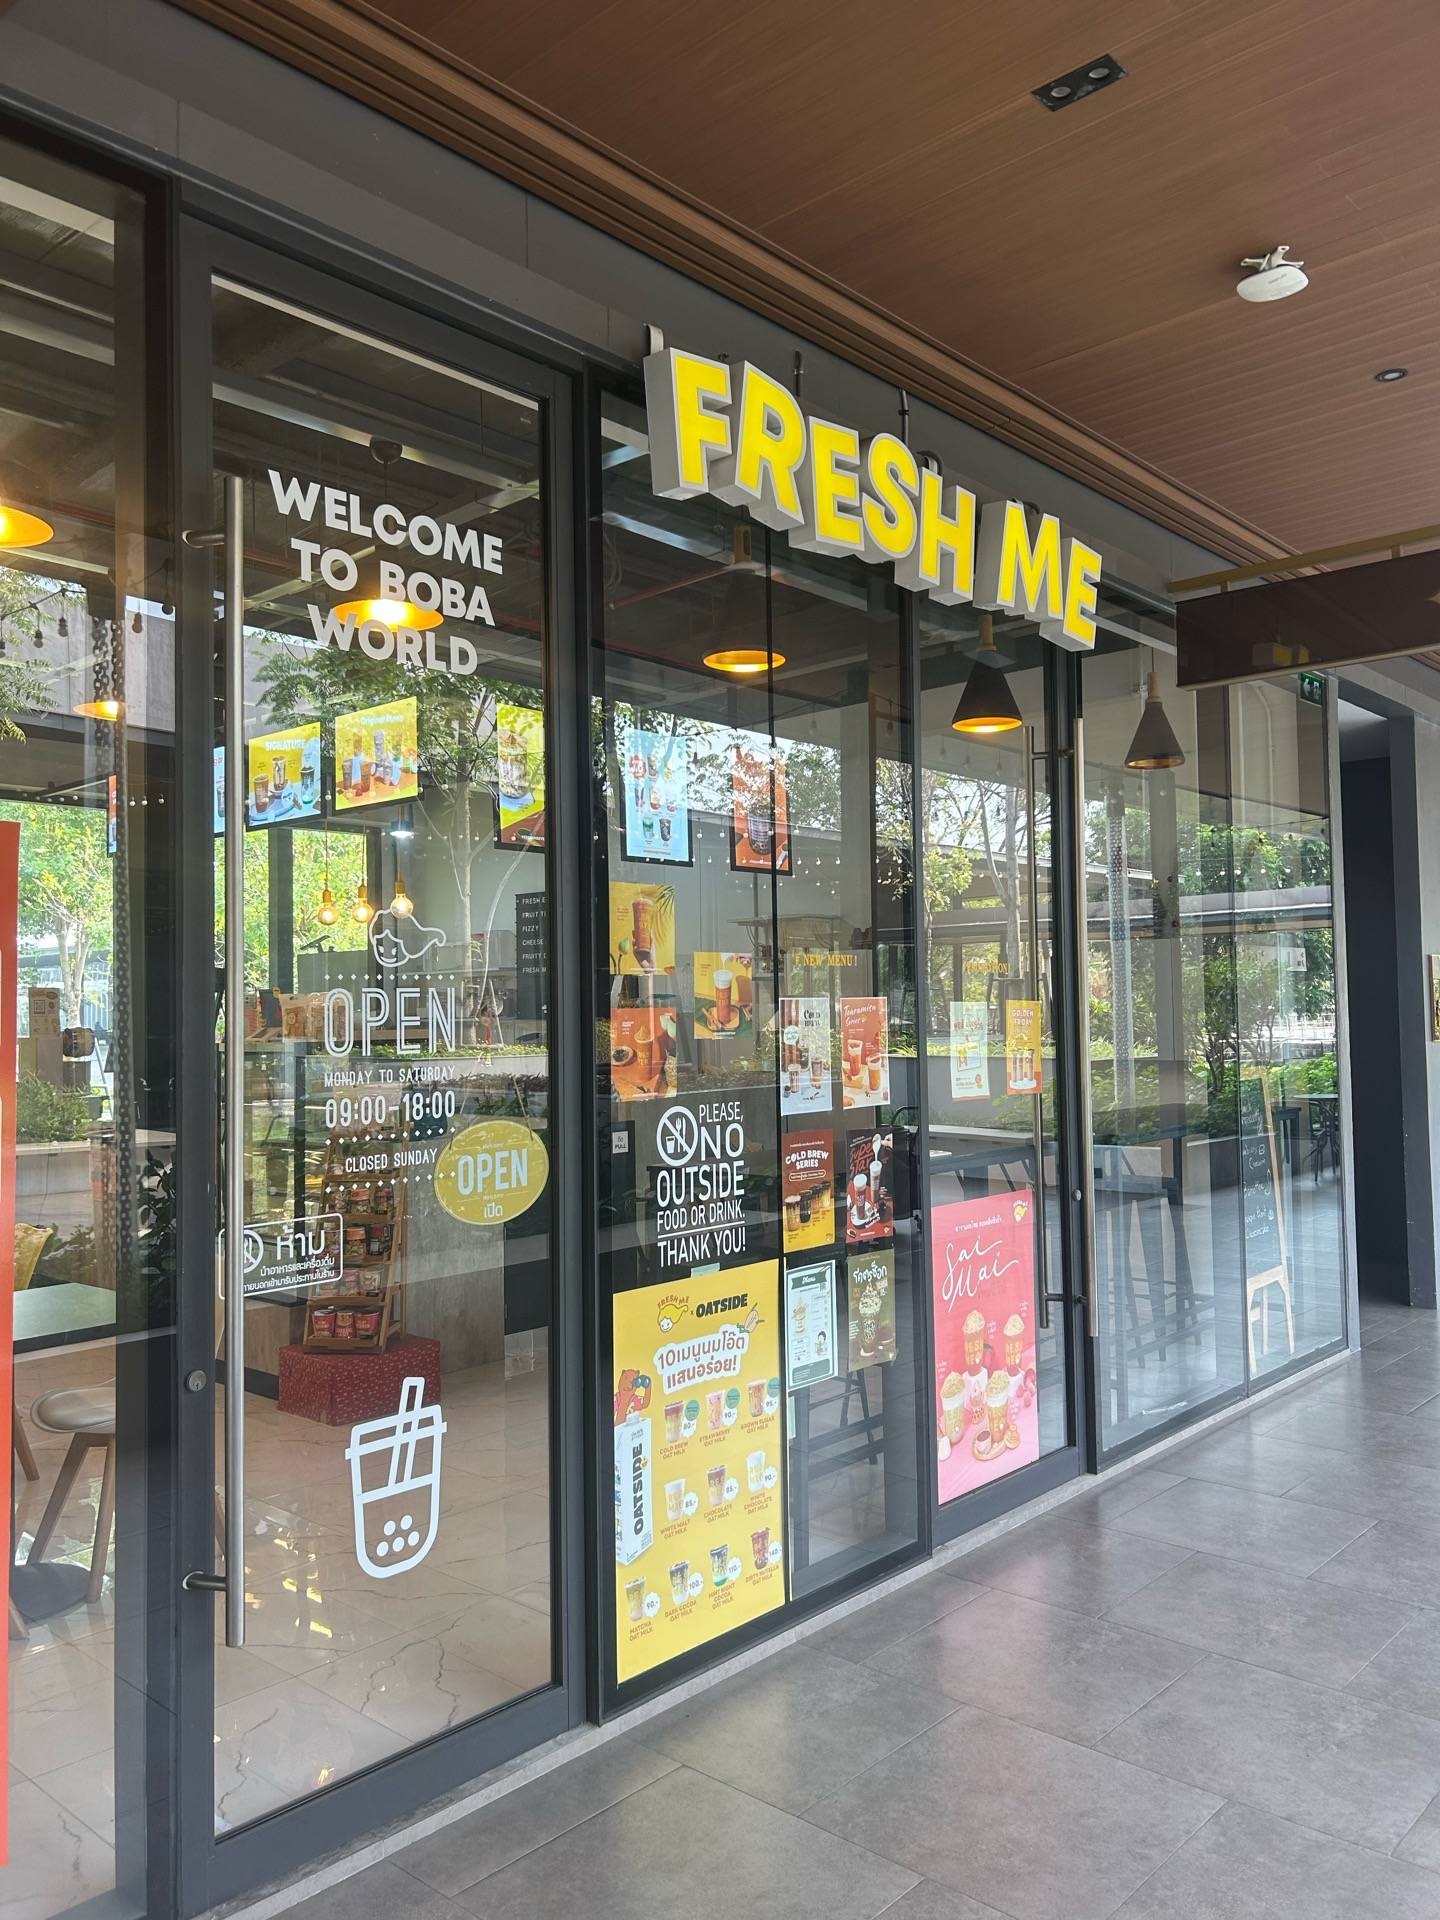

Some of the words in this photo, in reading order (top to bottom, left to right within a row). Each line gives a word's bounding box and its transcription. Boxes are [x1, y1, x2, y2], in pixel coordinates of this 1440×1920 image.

[669, 346, 977, 602] FRESH
[996, 499, 1103, 650] ME
[268, 469, 503, 575] WELCOME
[290, 537, 358, 591] TO
[379, 559, 496, 627] BOBA
[306, 603, 478, 676] WORLD
[522, 938, 544, 946] CHEESE
[324, 987, 456, 1058] OPEN
[1012, 1009, 1034, 1018] GOLDEN
[324, 1070, 373, 1088] MONDAY
[380, 1069, 394, 1084] TO
[399, 1065, 456, 1082] SATURDAY
[699, 1101, 744, 1123] PLEASE,
[700, 1122, 744, 1161] NO
[345, 1154, 388, 1173] CLOSED
[393, 1148, 438, 1167] SUNDAY
[785, 1150, 807, 1165] COLD
[807, 1149, 829, 1161] BREW
[795, 1159, 819, 1170] SERIES
[458, 1148, 528, 1196] OPEN
[656, 1160, 745, 1208] OUTSIDE
[657, 1208, 688, 1233] FOOD
[690, 1204, 706, 1226] OR
[709, 1199, 746, 1224] DRINK.
[276, 1224, 326, 1261] ห้าม
[657, 1233, 711, 1268] THANK
[713, 1226, 747, 1257] YOU!
[942, 1234, 1003, 1301] Sai
[947, 1251, 1020, 1313] Mai
[657, 1294, 679, 1309] FRESH
[678, 1295, 690, 1305] ME
[695, 1293, 749, 1318] OATSIDE
[666, 1355, 738, 1389] แสนอร่อย!
[659, 1445, 674, 1455] COLD
[674, 1441, 688, 1451] BREW
[662, 1451, 672, 1460] OAT
[673, 1447, 686, 1457] MILK
[632, 1442, 644, 1536] OATSIDE
[703, 1504, 733, 1519] CHOCOLATE
[743, 1496, 773, 1510] CHOCOLATE
[747, 1505, 757, 1514] OAT
[757, 1502, 769, 1512] MILK
[707, 1514, 717, 1523] OAT
[717, 1511, 730, 1521] MILK
[660, 1524, 677, 1535] WHITE
[663, 1531, 674, 1540] OAT
[675, 1527, 688, 1537] MILK
[712, 1601, 722, 1610] OAT
[722, 1597, 734, 1607] MILK
[713, 1592, 731, 1603] COCOA
[664, 1607, 679, 1619] DARK
[679, 1600, 697, 1613] COCOA
[670, 1613, 680, 1622] OAT
[681, 1608, 693, 1619] MILK
[629, 1621, 652, 1635] MATCHA
[629, 1632, 640, 1642] OAT
[640, 1627, 653, 1638] MILK
